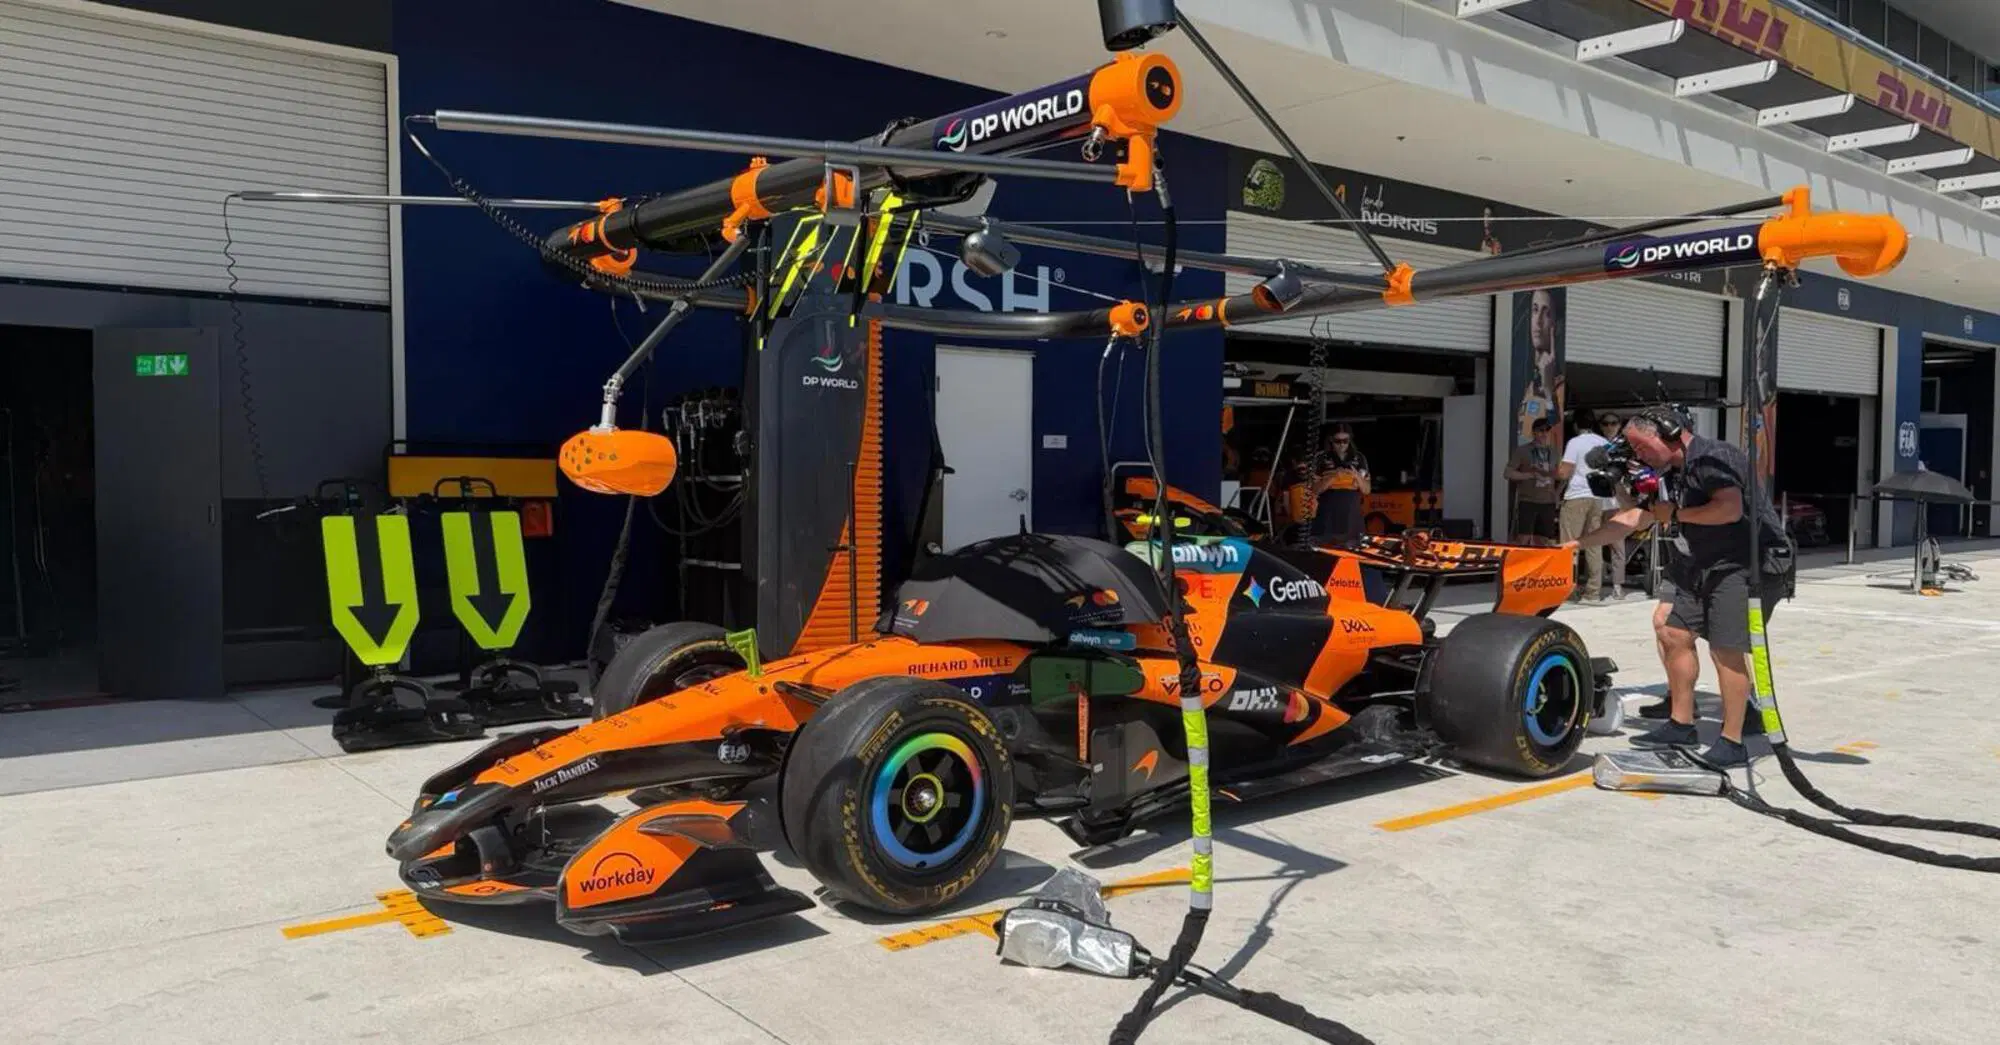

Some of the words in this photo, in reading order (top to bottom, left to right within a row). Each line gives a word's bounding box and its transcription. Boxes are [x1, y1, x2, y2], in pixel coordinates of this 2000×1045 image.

[970, 114, 999, 142] DP
[1001, 89, 1084, 133] WORLD
[1360, 210, 1439, 235] NORRIS
[1643, 245, 1670, 262] DP
[1674, 234, 1753, 259] WORLD
[802, 376, 819, 387] DP
[820, 377, 858, 389] WORLD
[1899, 429, 1916, 450] FIA
[1172, 544, 1239, 568] allwyn
[1269, 575, 1328, 603] Gemin
[1527, 576, 1568, 591] Dropbox
[1340, 619, 1375, 633] DELL
[908, 660, 968, 676] RICHARD
[972, 655, 1013, 669] MILLE
[719, 743, 748, 761] FIA
[532, 776, 558, 794] JACK
[557, 757, 600, 783] DANIEL'S
[580, 867, 656, 892] workday
